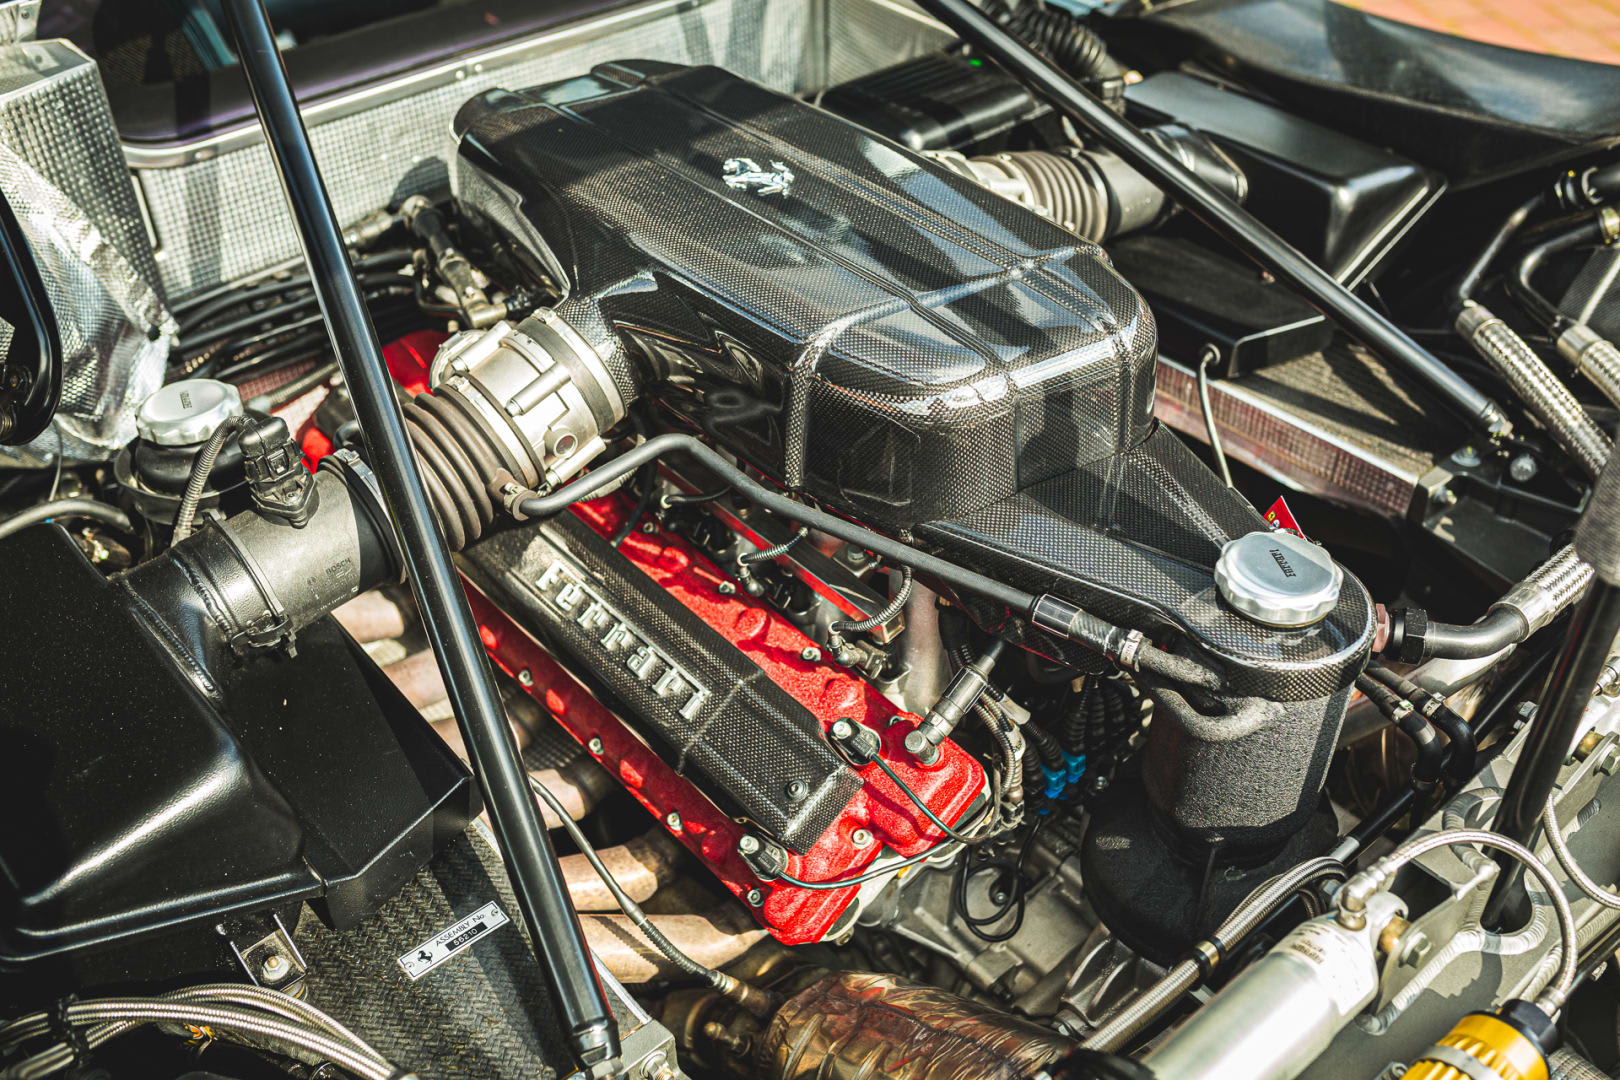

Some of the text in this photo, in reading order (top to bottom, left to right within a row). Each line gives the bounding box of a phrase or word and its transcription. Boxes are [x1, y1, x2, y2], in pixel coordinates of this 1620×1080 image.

[326, 557, 351, 574] BOSCH
[536, 559, 712, 720] Ferrari
[436, 921, 471, 947] ASSEMBLY
